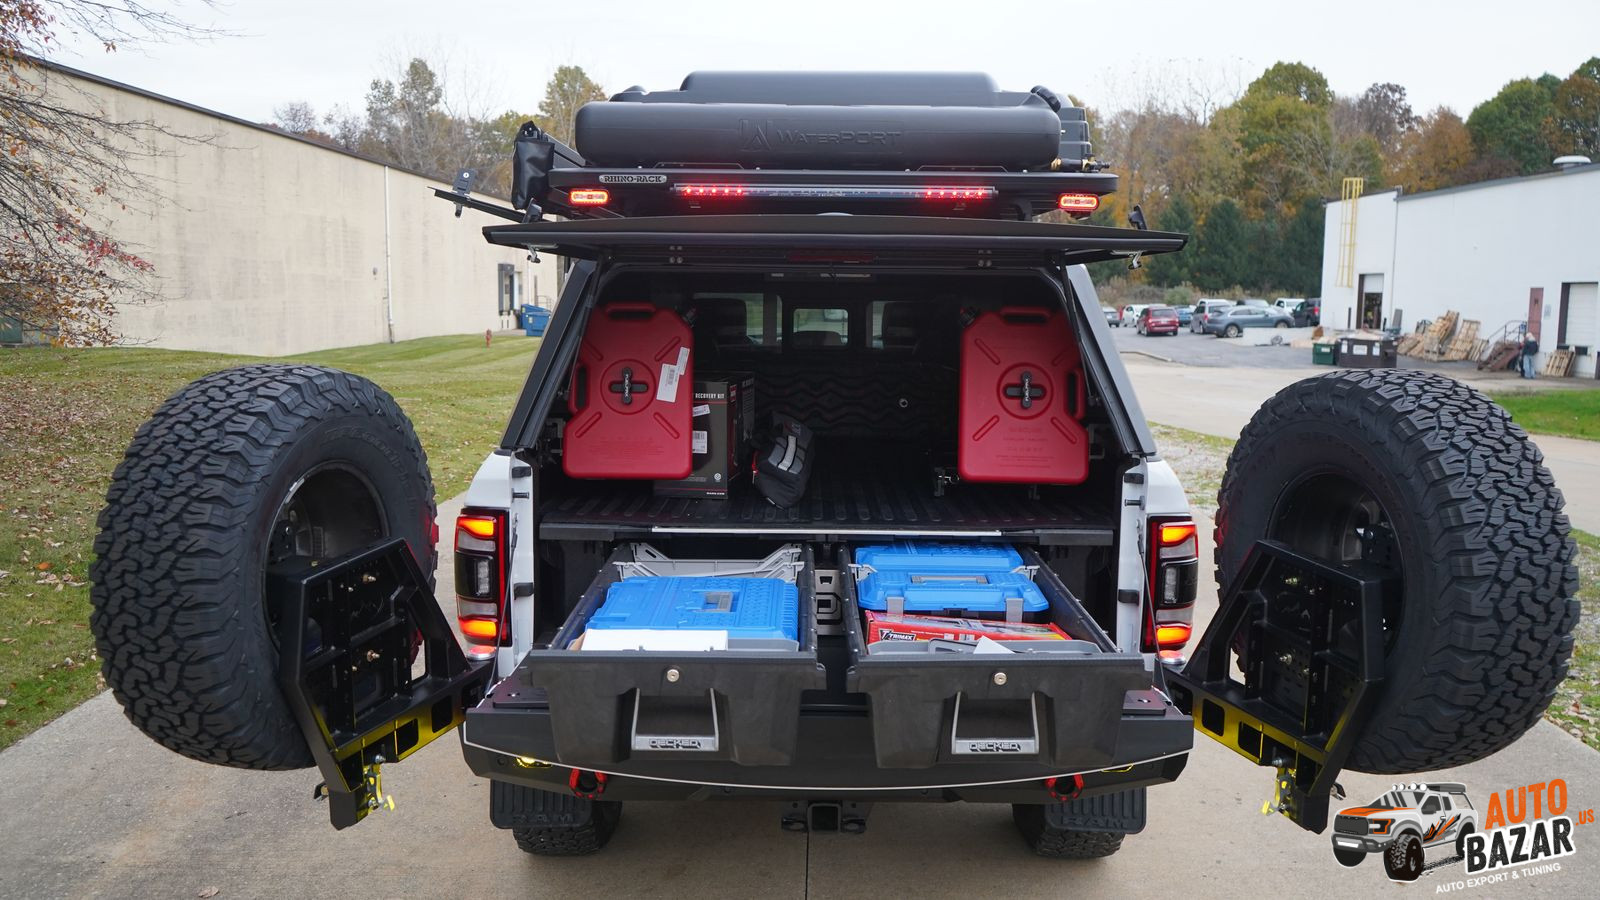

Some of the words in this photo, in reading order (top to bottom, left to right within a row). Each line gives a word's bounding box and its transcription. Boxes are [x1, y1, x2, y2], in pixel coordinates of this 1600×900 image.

[603, 175, 662, 183] RHINO-RACK
[649, 738, 701, 749] DECKED
[969, 742, 1021, 752] DECKED
